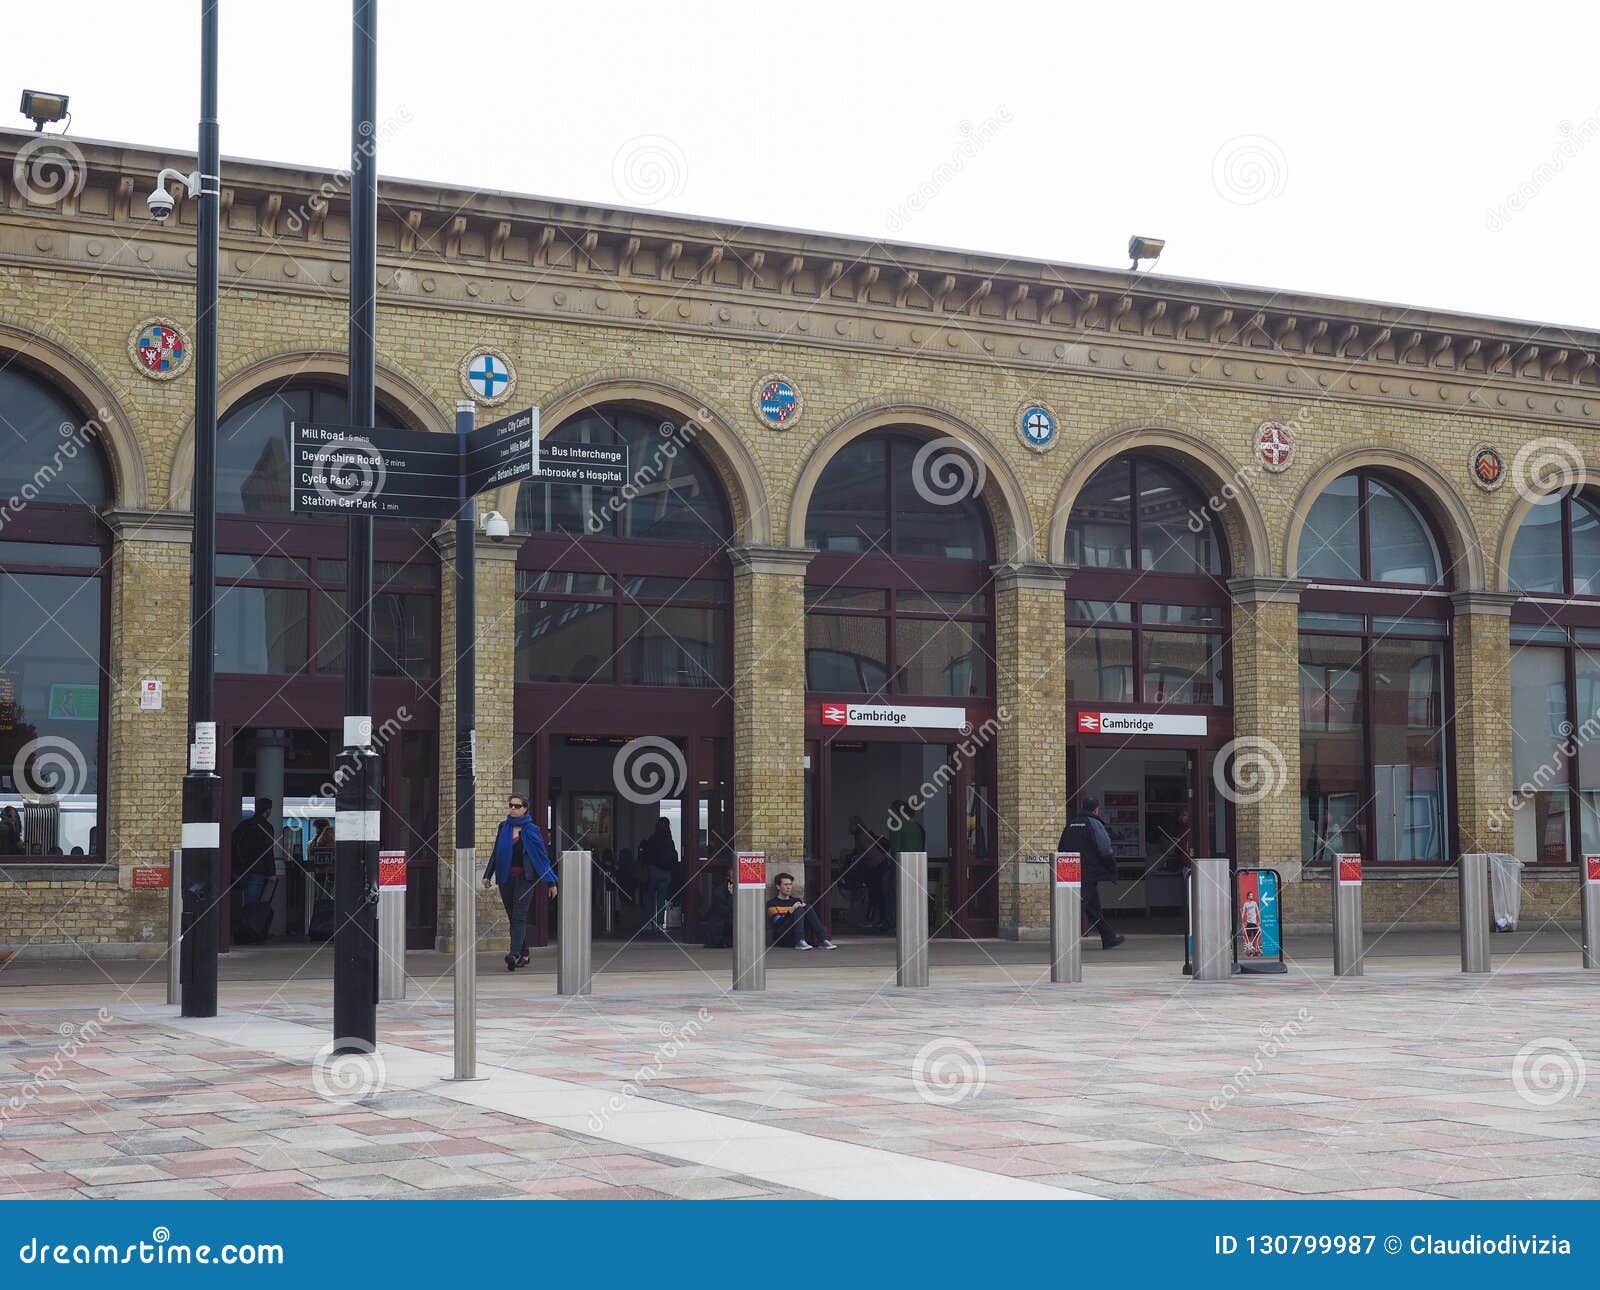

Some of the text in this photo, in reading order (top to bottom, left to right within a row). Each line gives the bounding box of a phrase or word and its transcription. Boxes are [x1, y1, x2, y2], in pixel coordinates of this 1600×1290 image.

[508, 421, 516, 432] City
[517, 417, 530, 428] Centre
[302, 429, 318, 439] Mill
[321, 430, 344, 441] Road
[520, 439, 531, 450] Road
[302, 451, 355, 463] Devonshire
[357, 455, 381, 465] Road
[552, 447, 568, 457] Bus
[570, 447, 622, 462] Interchange
[498, 468, 512, 481] Botanic
[513, 463, 530, 475] Gardens
[586, 470, 622, 483] Hospital
[302, 473, 328, 486] Cycle
[330, 475, 351, 486] Park
[302, 496, 337, 506] Station
[338, 498, 354, 507] Car
[356, 499, 378, 509] Park
[849, 709, 906, 724] Cambridge
[1102, 717, 1154, 731] Cambridge
